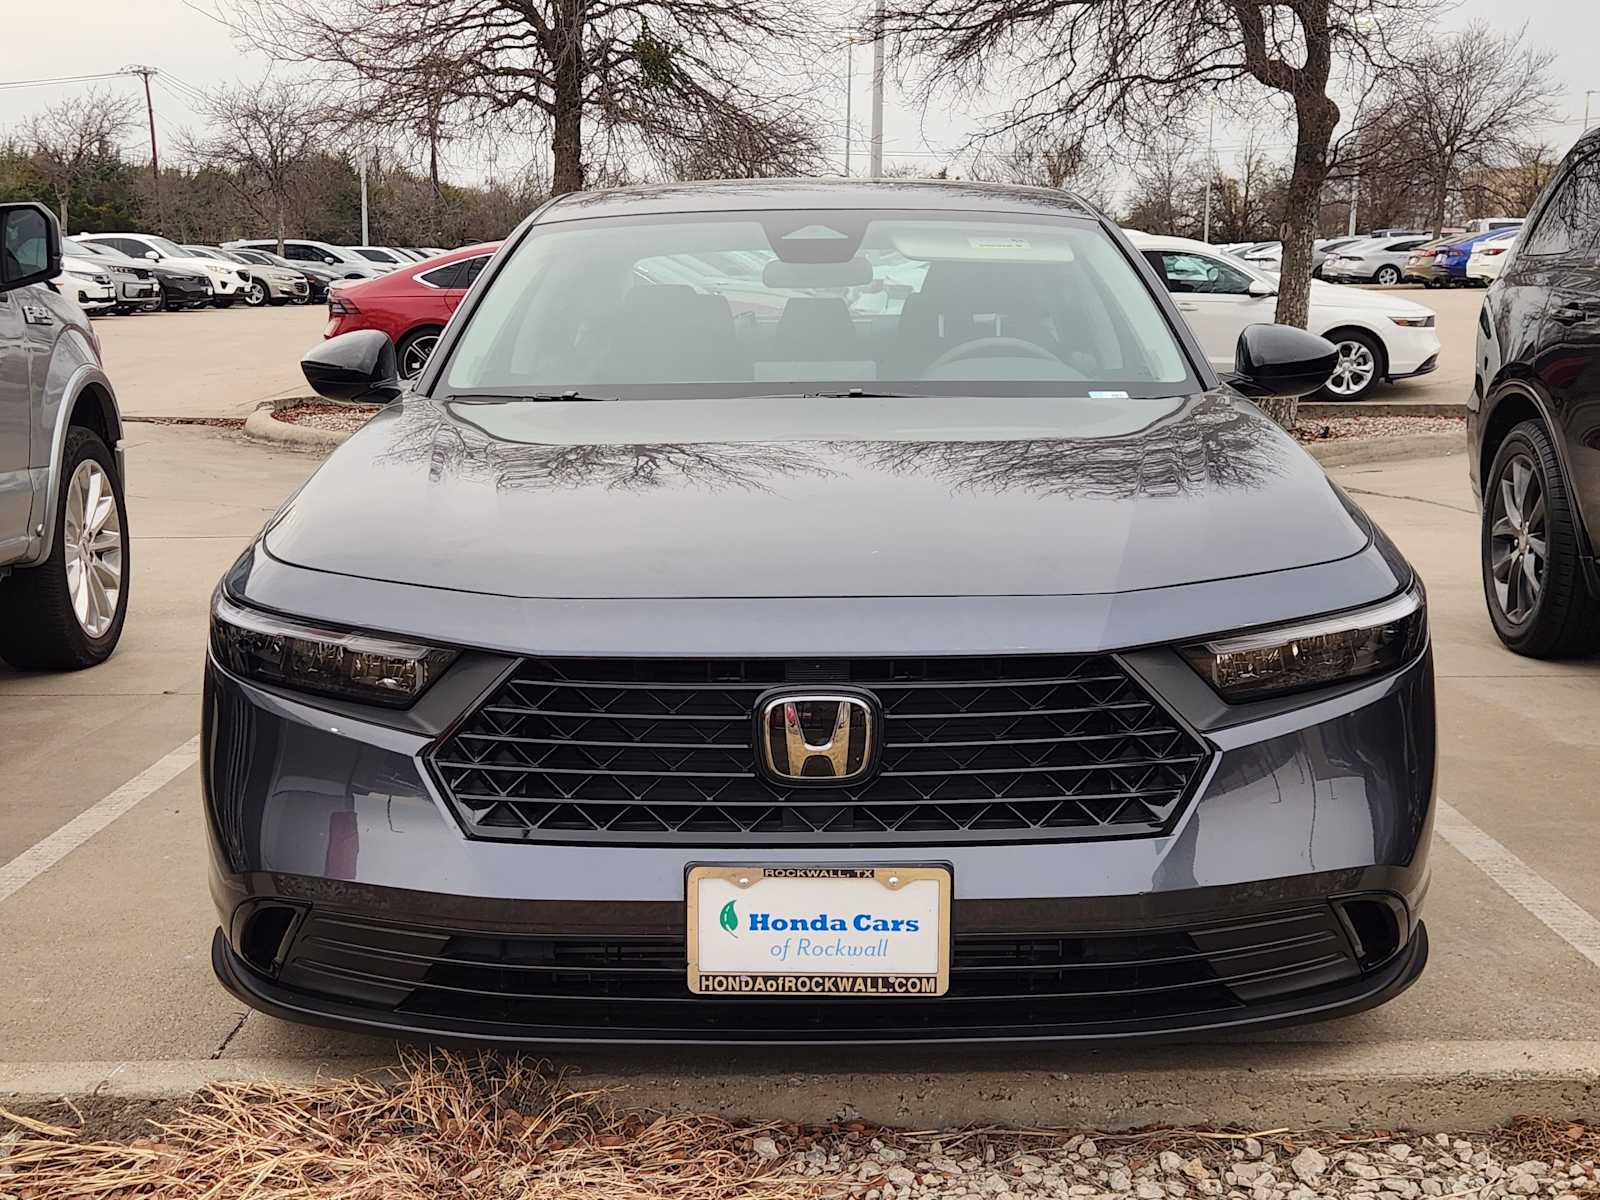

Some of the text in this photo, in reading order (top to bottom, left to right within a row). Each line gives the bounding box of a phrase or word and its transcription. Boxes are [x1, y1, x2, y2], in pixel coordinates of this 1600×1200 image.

[854, 869, 873, 878] TX
[749, 914, 920, 932] Honda Cars
[770, 938, 888, 962] of Rockwall
[701, 975, 936, 993] HONDAofROCKWALL.COM
